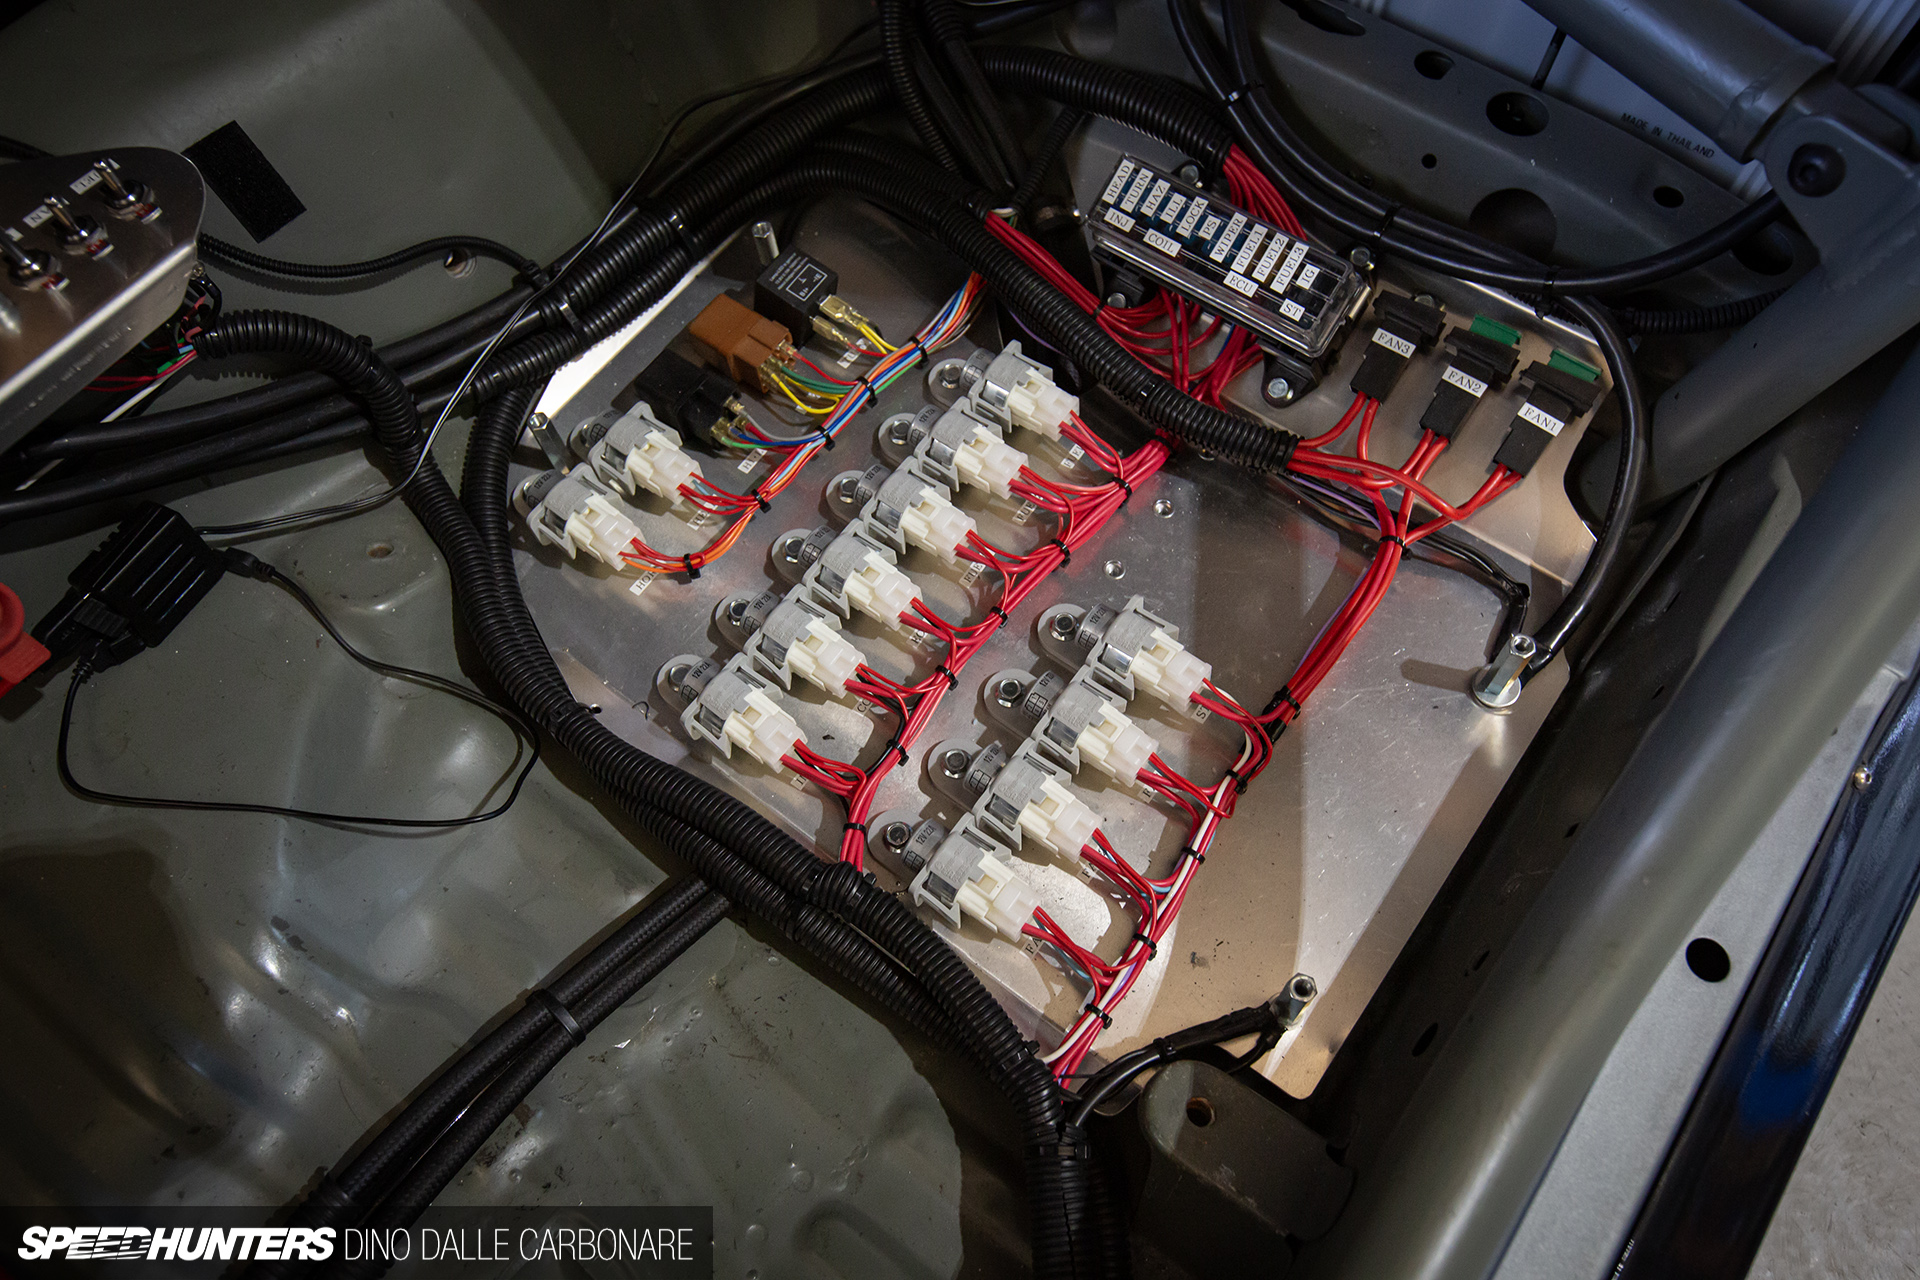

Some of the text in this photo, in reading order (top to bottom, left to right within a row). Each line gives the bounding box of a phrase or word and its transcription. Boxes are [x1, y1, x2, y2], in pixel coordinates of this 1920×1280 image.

[1621, 113, 1715, 158] MADE IN THAILAND
[1109, 164, 1131, 199] HEAD
[1125, 172, 1149, 207] TURN
[1147, 185, 1167, 211] HAZ
[1165, 198, 1183, 218] ILL
[1109, 213, 1129, 227] INJ
[1183, 200, 1205, 232] LOCK
[1203, 219, 1217, 235] PS
[1214, 213, 1243, 257] WIPER
[1148, 234, 1174, 252] COIL
[1237, 230, 1264, 268] FUEL1
[1257, 238, 1285, 277] FUEL2
[1277, 247, 1305, 287] FUEL3
[1228, 275, 1253, 292] ECU
[1302, 268, 1315, 284] IG
[1283, 303, 1301, 317] ST
[1377, 332, 1411, 354] FAN3
[1449, 371, 1482, 393] FAN2
[1525, 408, 1558, 432] FAN1
[963, 562, 983, 582] FUE
[753, 600, 764, 610] 12V
[1088, 614, 1100, 624] 12V
[691, 668, 703, 679] 12V
[914, 833, 928, 845] 12V
